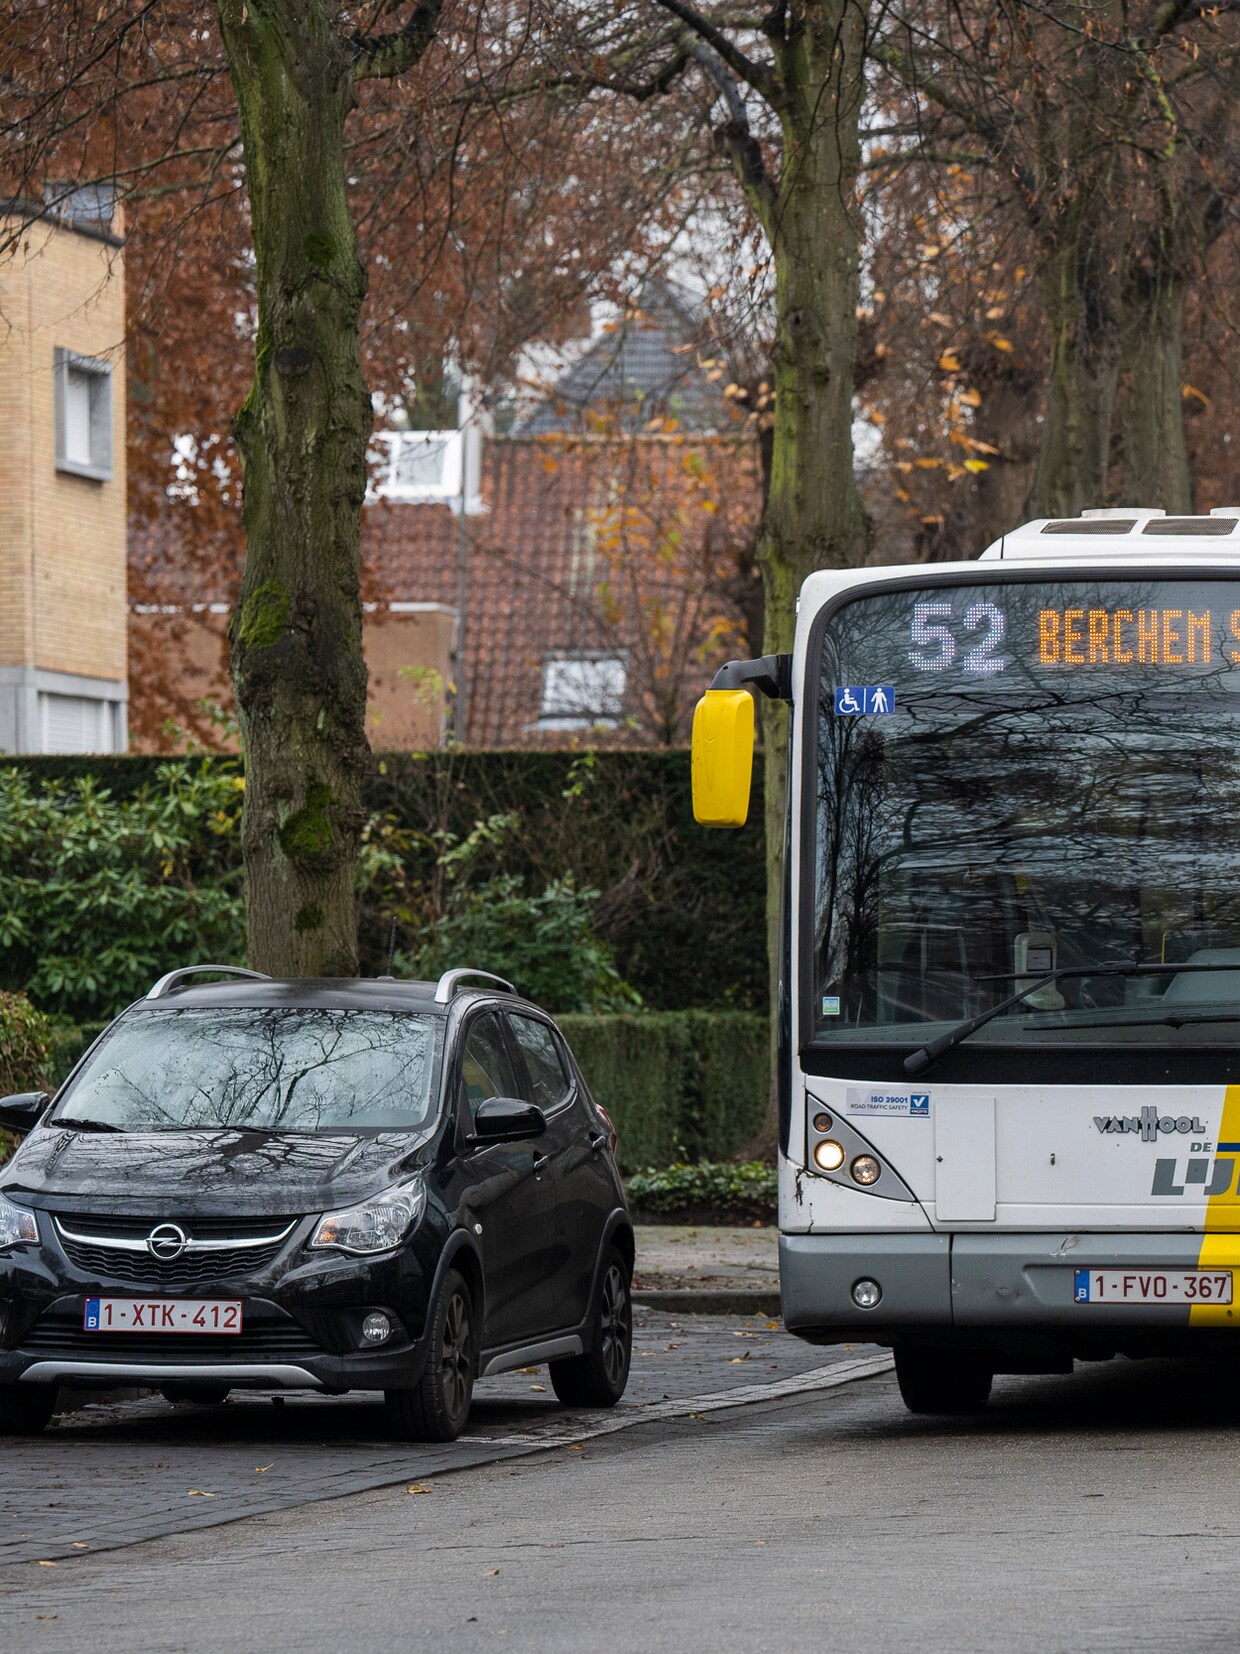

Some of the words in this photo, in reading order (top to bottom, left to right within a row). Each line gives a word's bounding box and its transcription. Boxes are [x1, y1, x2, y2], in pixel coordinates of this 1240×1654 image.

[908, 603, 1004, 671] 52
[1039, 609, 1211, 663] BERCHEM
[1078, 1288, 1087, 1299] B
[1095, 1275, 1227, 1299] 1-FVO-367
[87, 1316, 97, 1327] B
[104, 1303, 238, 1328] 1-XTK-412
